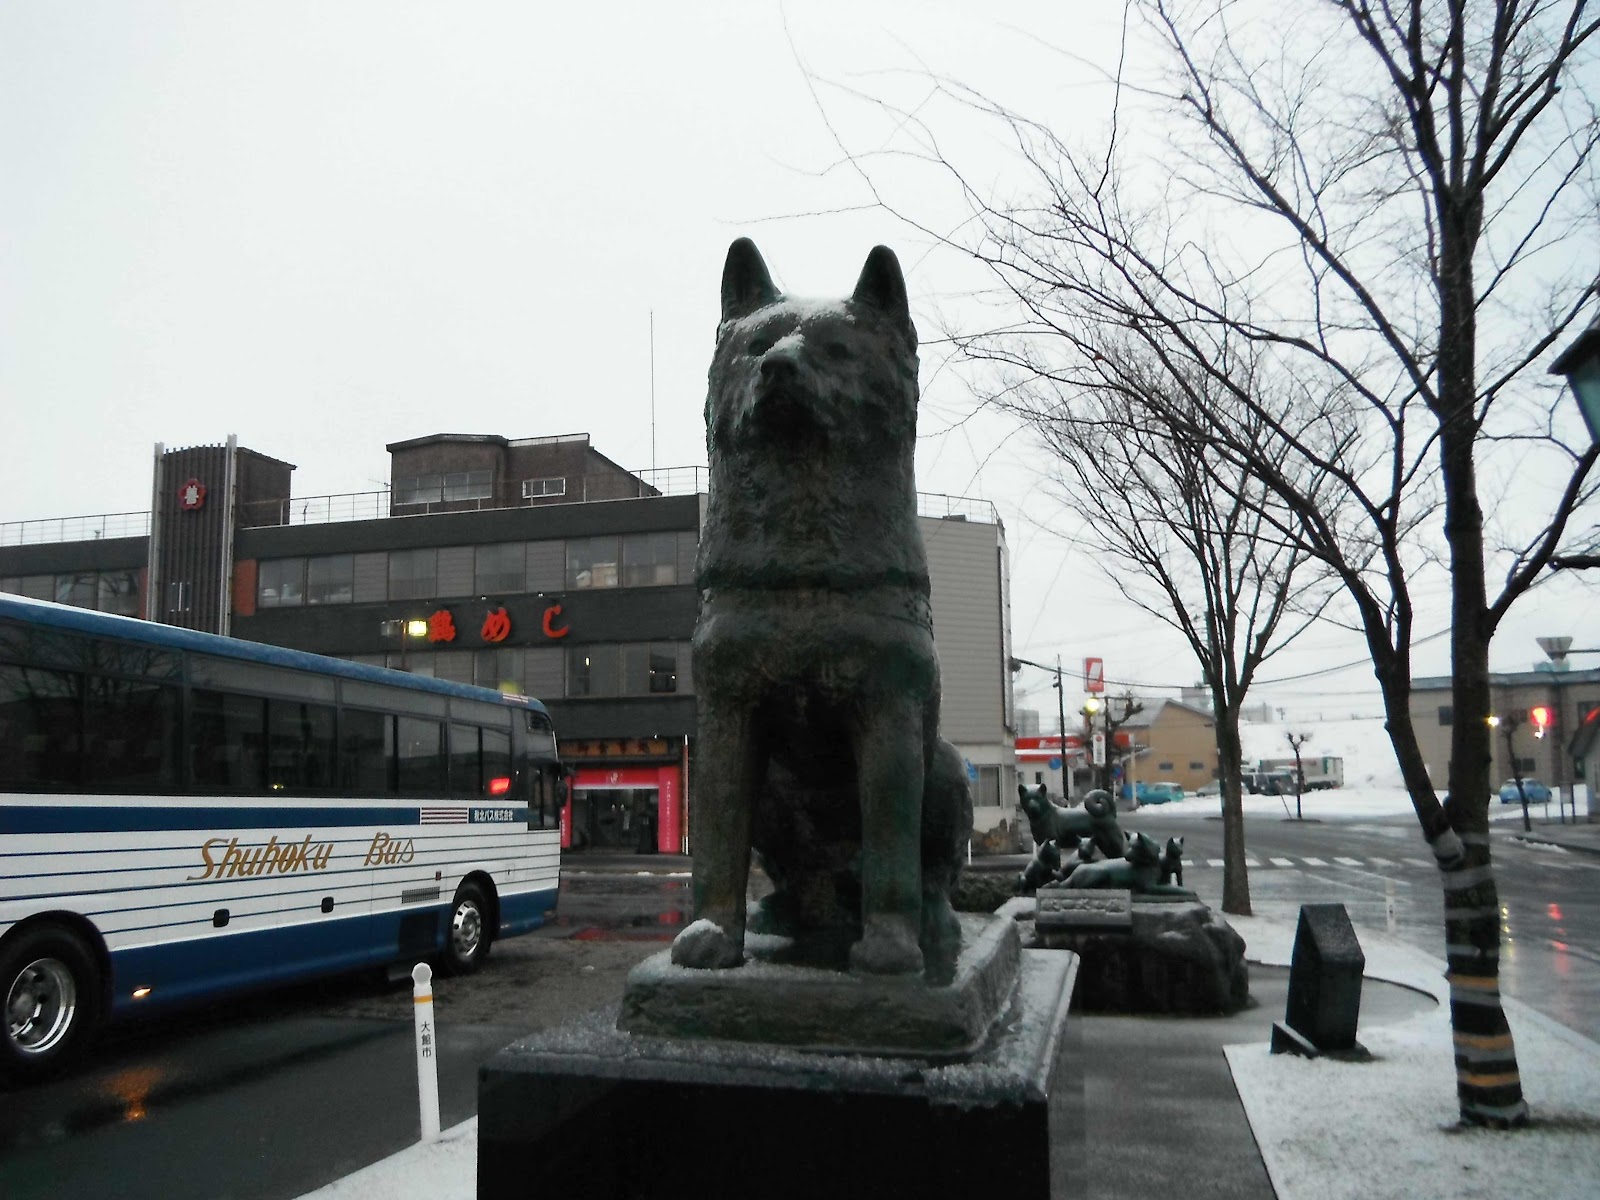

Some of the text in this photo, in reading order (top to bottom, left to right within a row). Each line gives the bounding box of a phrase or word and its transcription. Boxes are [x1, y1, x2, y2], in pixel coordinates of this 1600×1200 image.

[187, 831, 415, 881] Shuhoku Bus
[421, 1020, 432, 1058] 大館市
